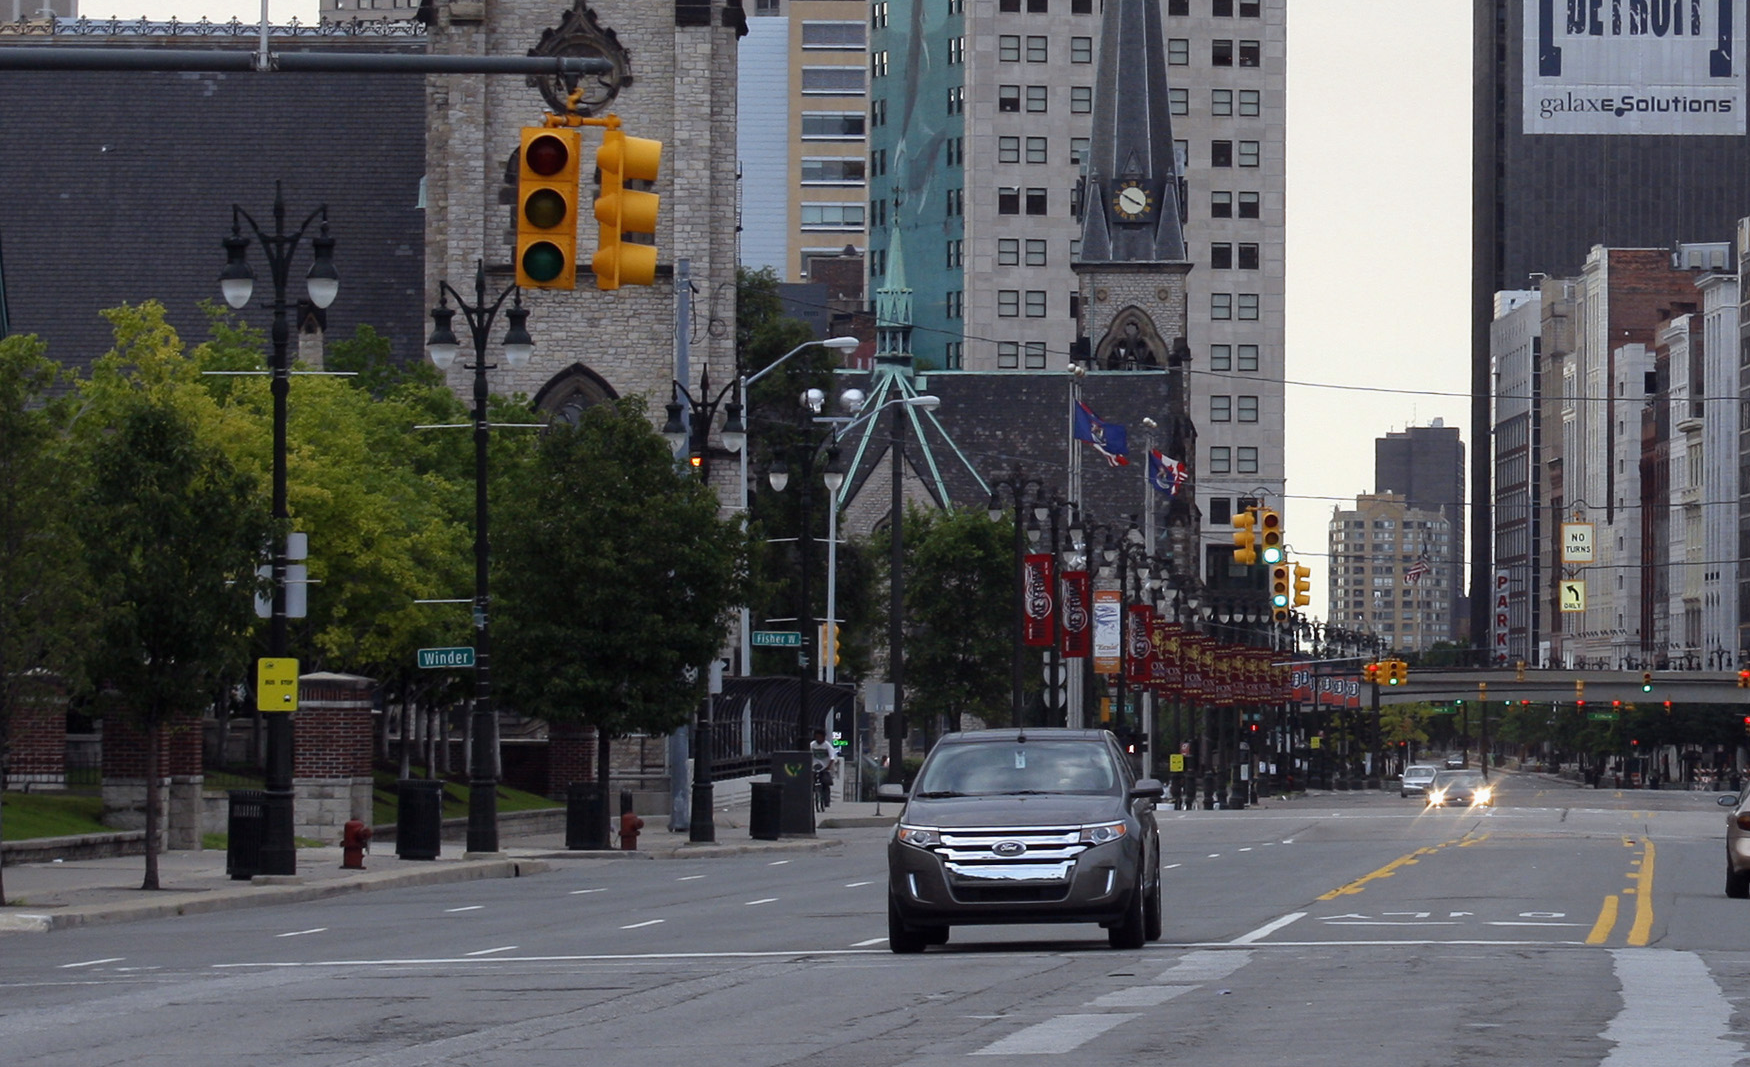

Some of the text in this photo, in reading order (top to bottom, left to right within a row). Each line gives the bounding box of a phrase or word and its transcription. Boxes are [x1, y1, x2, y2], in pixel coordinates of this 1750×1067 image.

[1571, 533, 1585, 542] NO
[1565, 545, 1591, 553] TURNS
[1497, 576, 1509, 646] PARK
[757, 634, 785, 644] Fisher
[424, 651, 468, 665] Winder
[1151, 662, 1166, 670] OX
[1184, 674, 1202, 682] FOX
[1000, 843, 1020, 853] Ford
